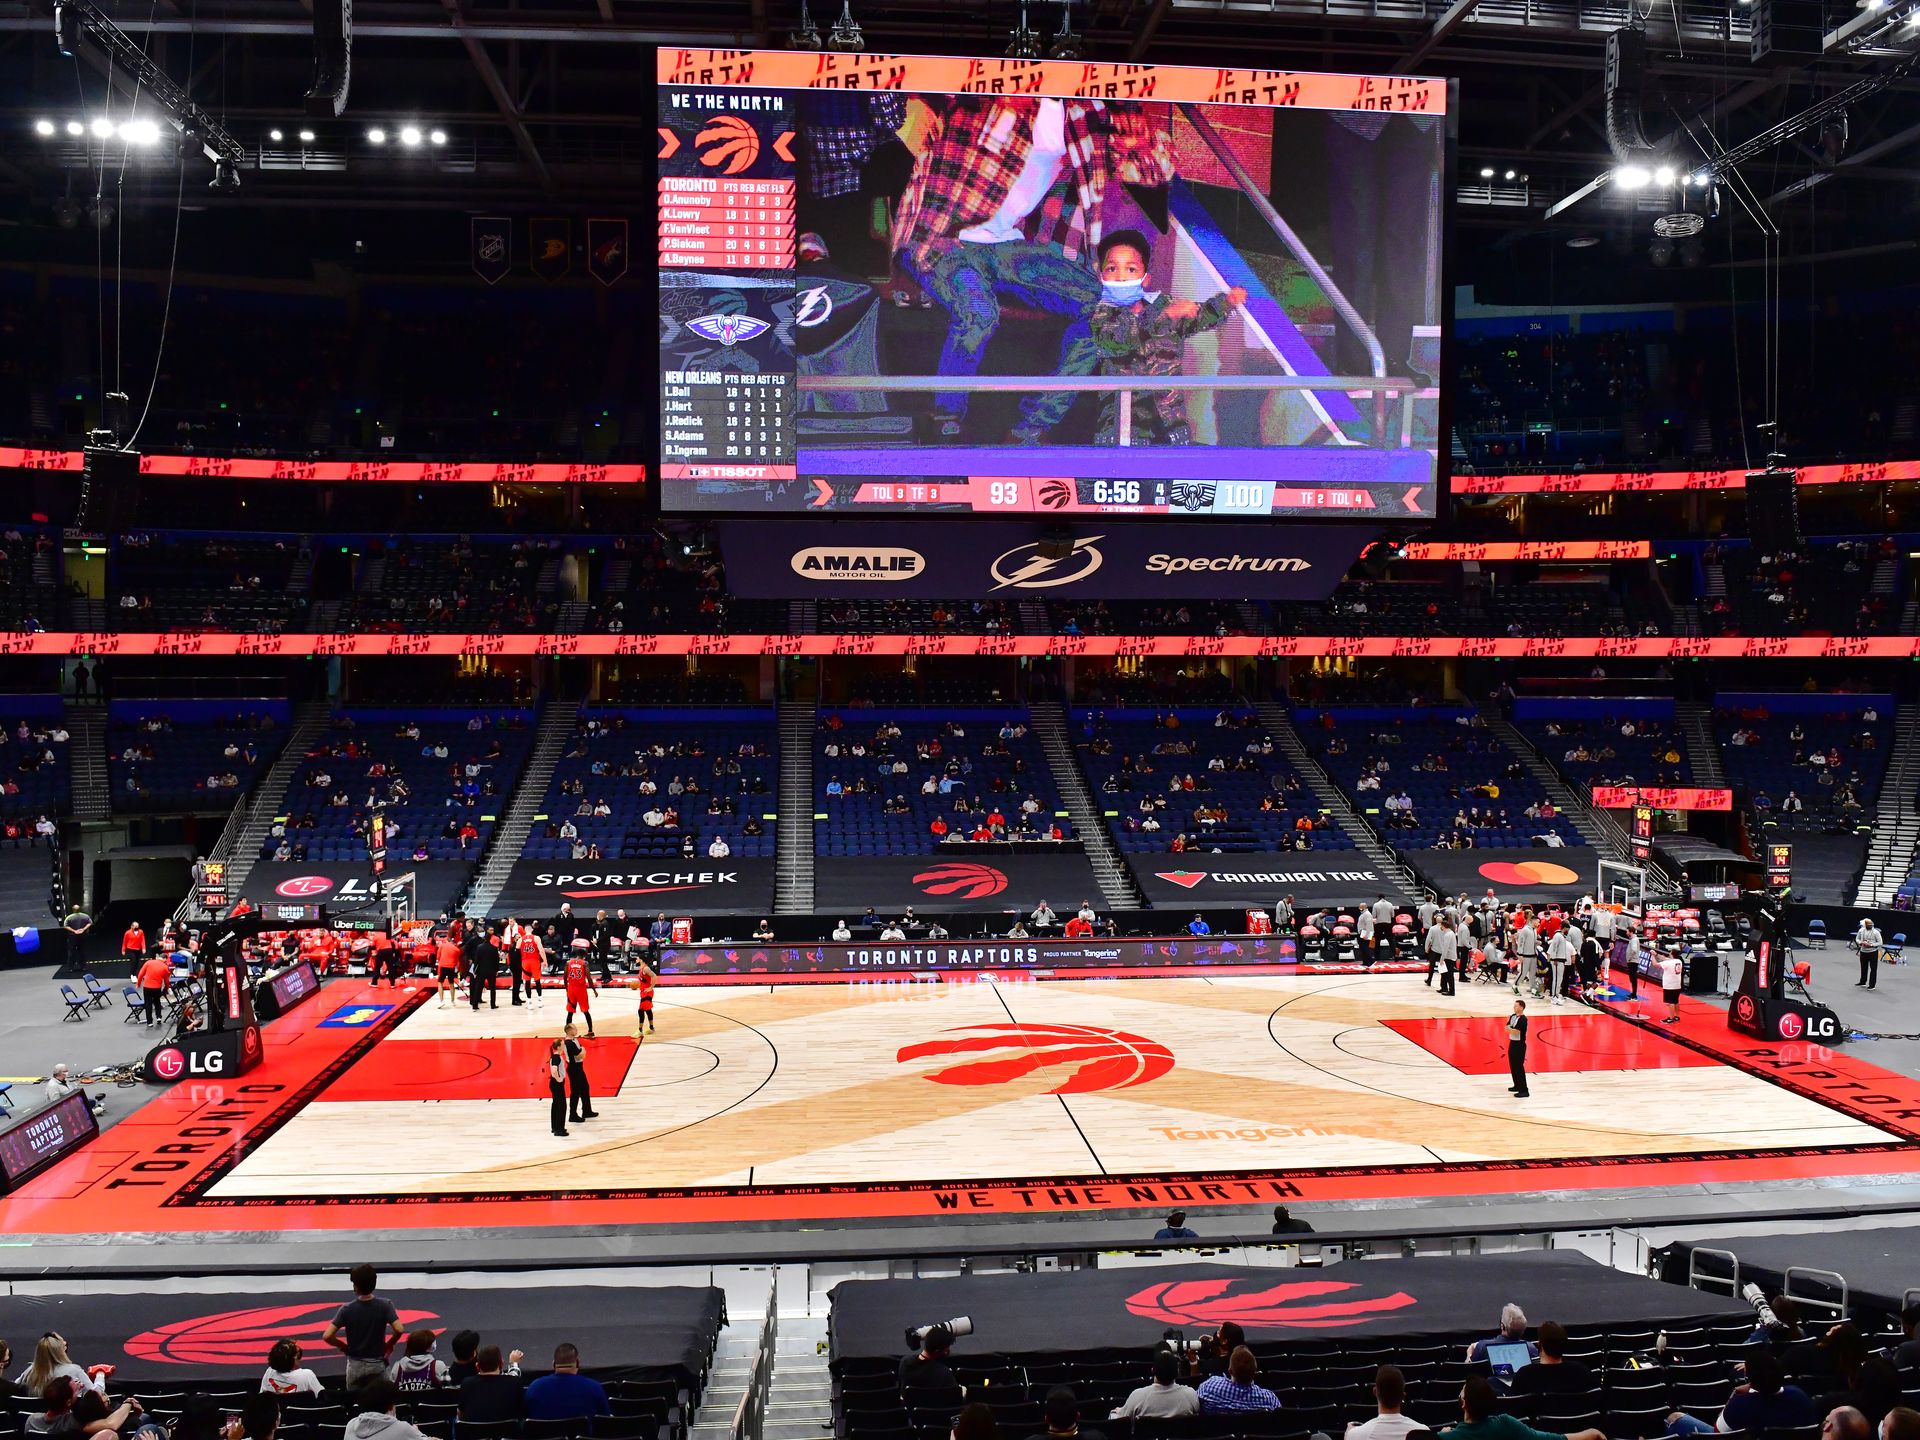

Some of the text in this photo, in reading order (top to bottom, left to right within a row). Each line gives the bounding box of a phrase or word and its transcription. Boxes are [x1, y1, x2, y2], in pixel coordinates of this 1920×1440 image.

[672, 93, 783, 111] WE THE NORTH
[663, 178, 785, 194] TORONTO PTS REB AST FLS
[663, 194, 781, 207] O.Anunoby 8 7 2 3
[663, 208, 700, 220] K.Lowry
[726, 210, 737, 220] 18
[744, 211, 750, 220] 1
[774, 211, 781, 221] 3
[663, 223, 710, 235] F.VanVleet
[744, 226, 750, 235] 1
[663, 239, 705, 249] P.Siakam
[726, 240, 737, 250] 20
[744, 241, 750, 250] 4
[775, 241, 780, 251] 1
[663, 253, 705, 266] A.Baynes
[726, 255, 736, 264] 11
[774, 256, 781, 265] 2
[665, 371, 785, 385] NEW ORLEANS PTS REB AST FLS
[665, 386, 690, 397] L.Ball
[744, 388, 751, 397] 4
[760, 388, 766, 398] 1
[775, 388, 781, 398] 3
[665, 400, 692, 411] J.Hart
[744, 402, 751, 412] 2
[760, 402, 766, 412] 1
[775, 402, 781, 412] 1
[665, 415, 703, 426] J.Redick
[744, 417, 751, 426] 2
[760, 417, 766, 427] 1
[775, 417, 781, 427] 3
[665, 430, 704, 441] S.Adams
[775, 432, 781, 441] 1
[665, 445, 707, 457] B.Ingram
[726, 446, 738, 456] 20
[775, 446, 782, 456] 2
[711, 467, 766, 477] TISSOT
[872, 486, 937, 499] TOL 3 TF 3
[990, 481, 1017, 505] 93
[1094, 480, 1140, 503] 6:56
[1155, 483, 1165, 496] 4
[1224, 485, 1263, 508] 100
[1301, 492, 1362, 505] TF 2 TOL 4
[802, 556, 916, 571] AMALIE
[1145, 554, 1304, 575] Spectrum
[1638, 821, 1649, 836] 14
[1776, 857, 1786, 865] 14
[208, 874, 220, 885] 14
[534, 872, 738, 886] SPORTCHEK
[1211, 871, 1379, 883] CANADIAN TIRE
[334, 921, 374, 929] Uber Eats
[523, 944, 534, 953] 46
[847, 950, 937, 966] TORONTO
[948, 948, 1037, 964] RAPTORS
[1083, 949, 1118, 959] Tangerine
[569, 969, 583, 979] 43
[1807, 1017, 1834, 1037] LG
[190, 1050, 223, 1073] LG
[26, 1114, 59, 1138] TORONTO
[1149, 1121, 1378, 1142] Tangerine
[30, 1125, 64, 1150] RAPTORS
[104, 1084, 287, 1189] TORONTO
[933, 1181, 1304, 1209] WE THE NORTH
